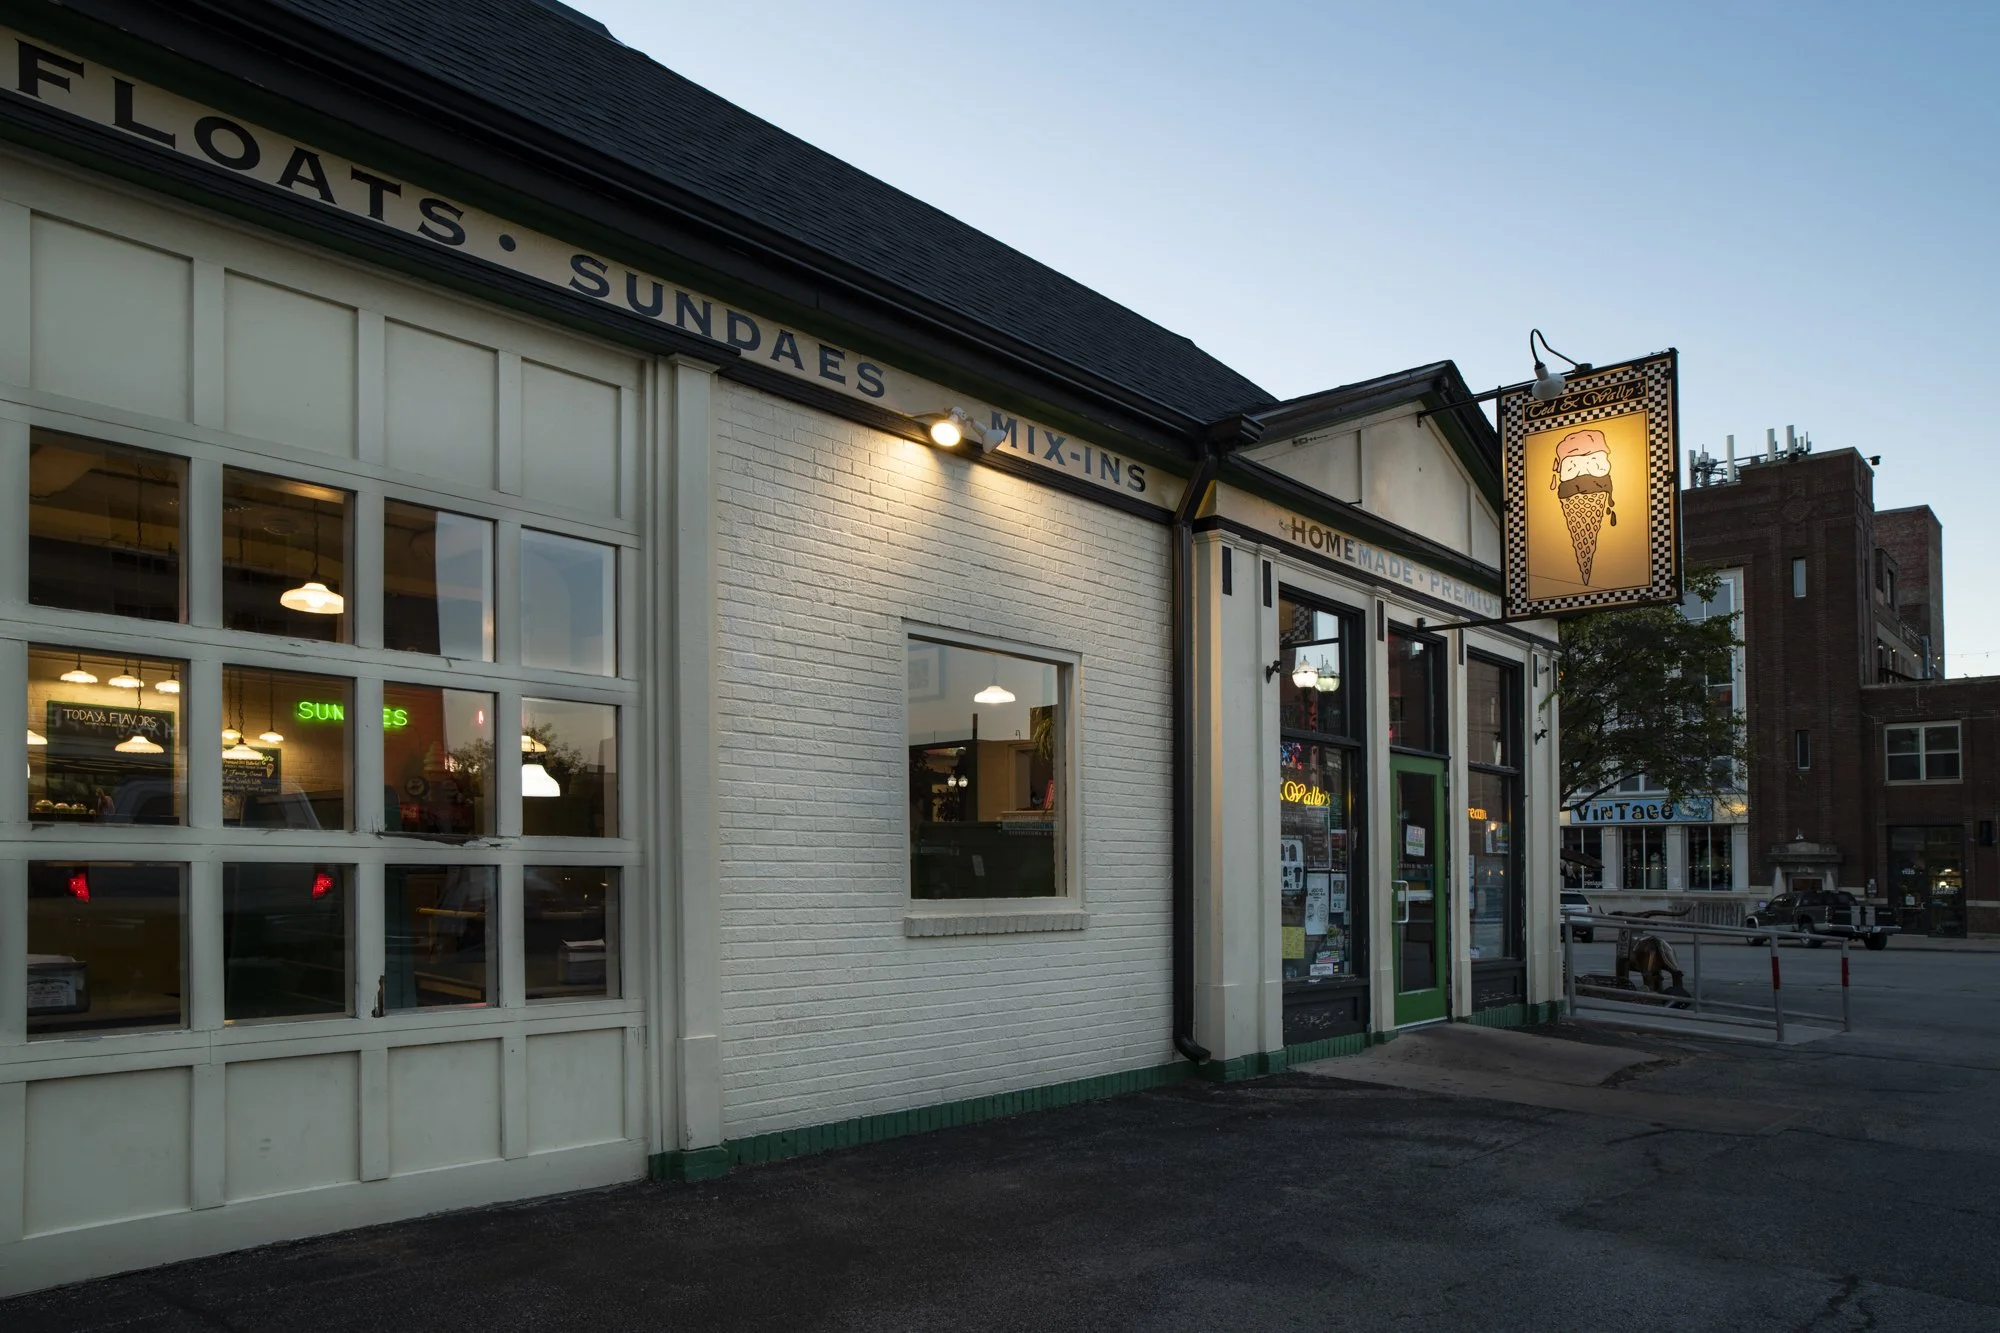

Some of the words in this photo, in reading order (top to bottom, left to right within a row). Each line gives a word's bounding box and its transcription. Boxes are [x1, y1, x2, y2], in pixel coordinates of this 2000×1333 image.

[14, 39, 467, 247] FLOATS
[568, 253, 886, 399] SUNDAES
[990, 409, 1147, 493] MIX-INS
[1525, 401, 1557, 418] Ted
[1560, 396, 1580, 411] &
[1583, 382, 1646, 406] Wally's
[1291, 516, 1413, 585] HOMEMADE
[298, 701, 408, 727] SUNES
